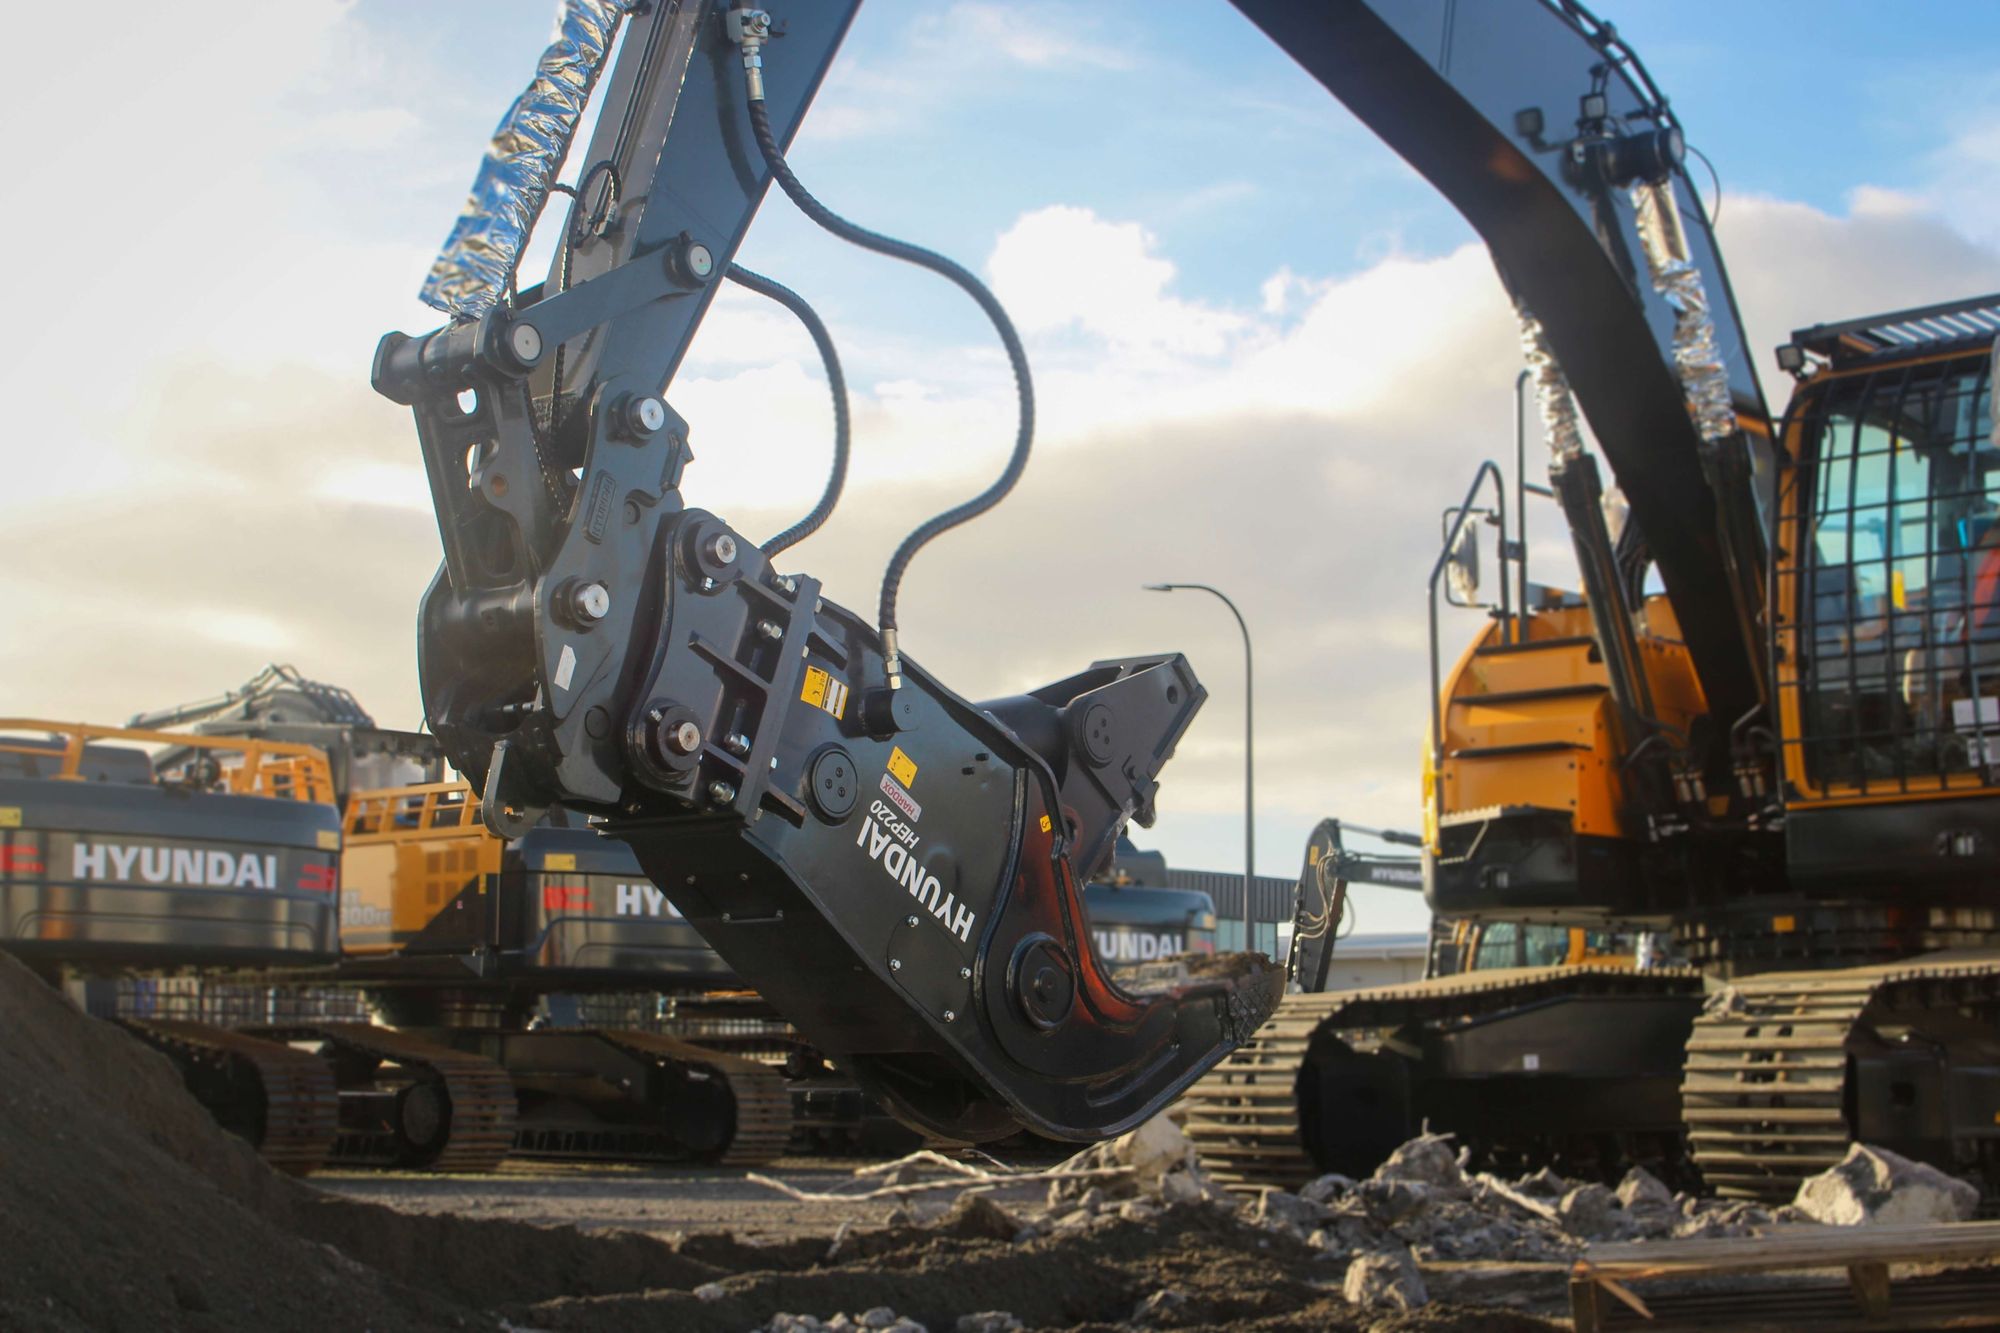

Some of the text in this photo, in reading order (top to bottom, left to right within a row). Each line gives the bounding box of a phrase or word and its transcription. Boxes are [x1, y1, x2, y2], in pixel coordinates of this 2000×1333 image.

[882, 781, 915, 815] HARDOX
[870, 799, 920, 849] HEP220
[73, 843, 277, 889] HYUNDAI
[856, 815, 976, 943] HYUNDAI
[1093, 930, 1184, 959] UNDAI
